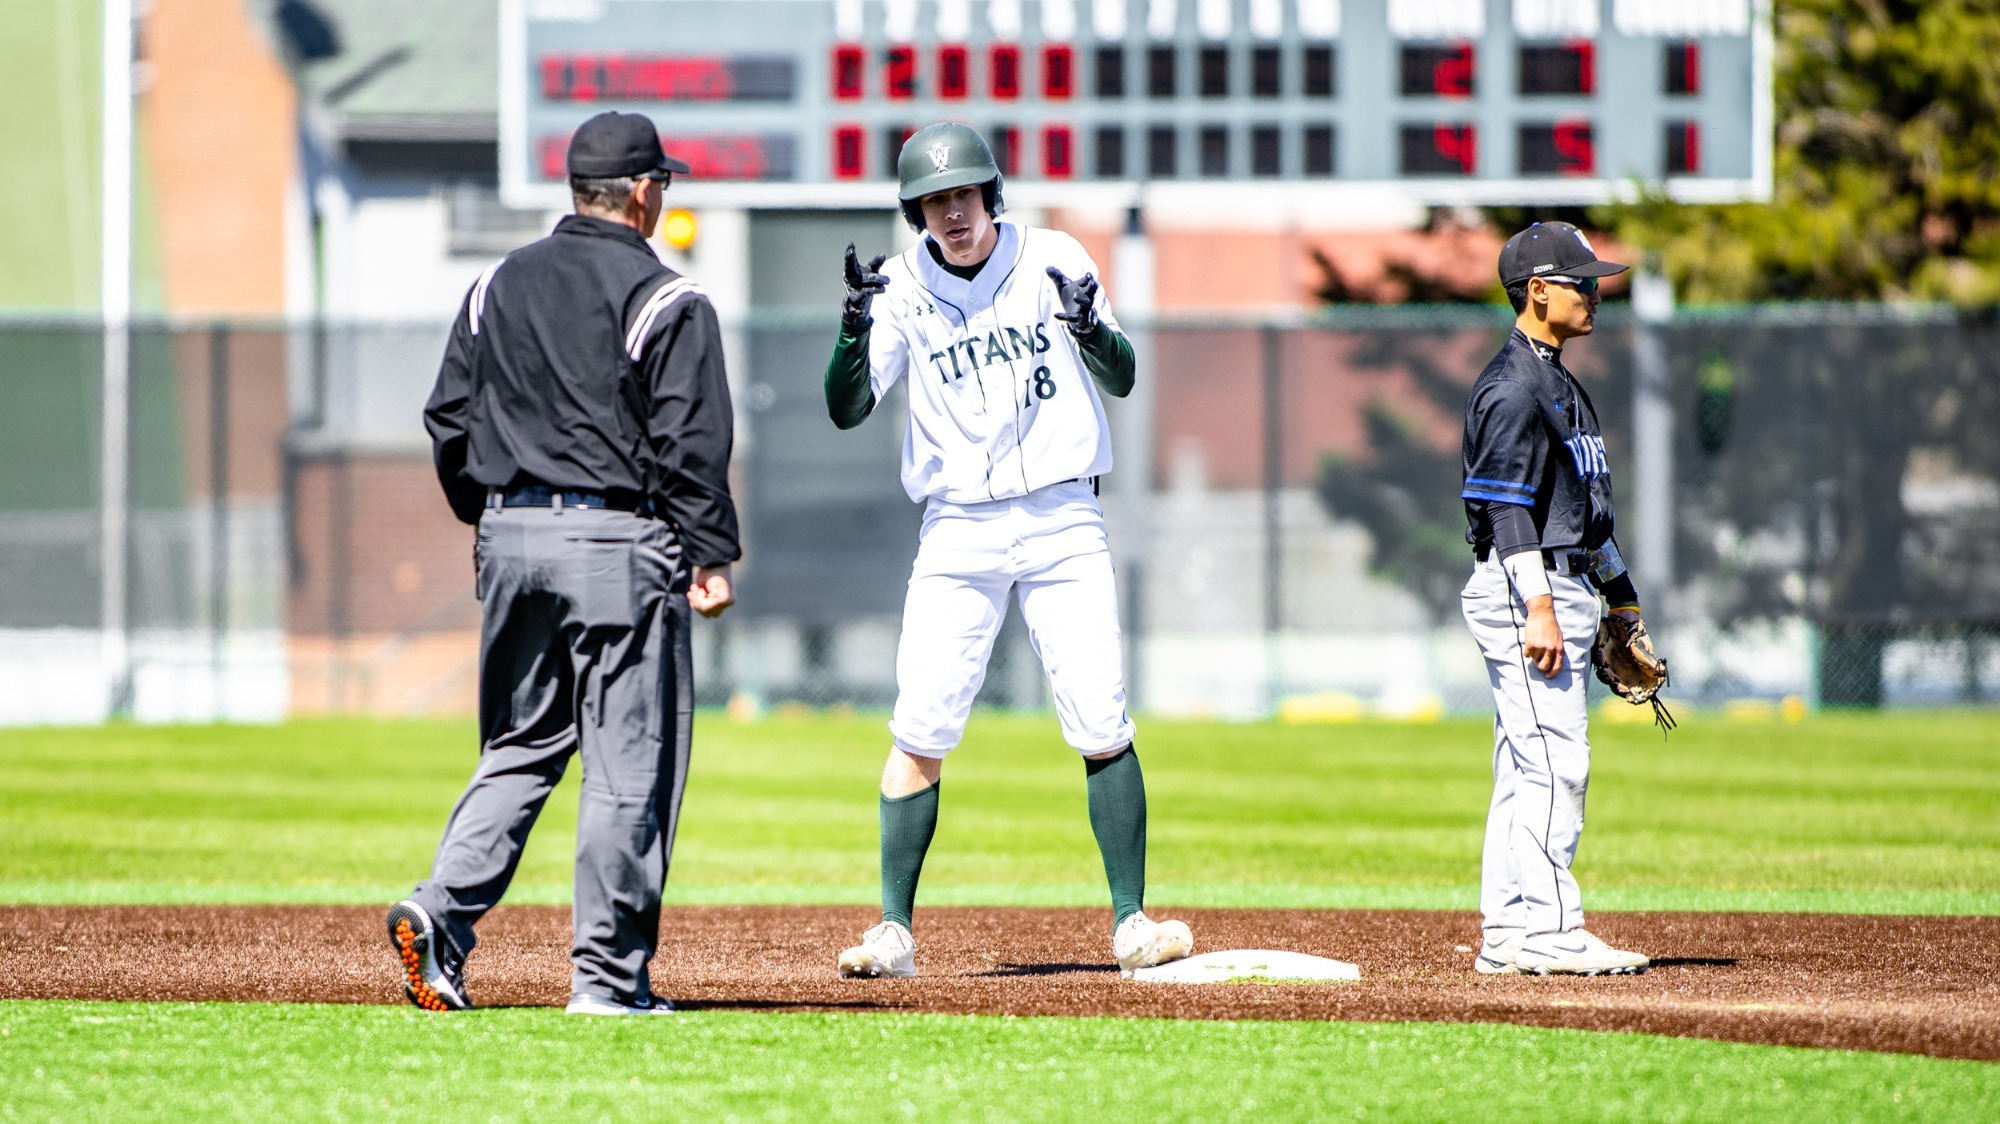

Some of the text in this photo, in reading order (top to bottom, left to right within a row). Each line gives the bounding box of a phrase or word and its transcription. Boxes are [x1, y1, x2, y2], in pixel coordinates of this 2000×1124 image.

[884, 43, 914, 99] 2
[1432, 42, 1474, 98] 2
[1432, 120, 1475, 176] 4
[1552, 117, 1594, 178] 5
[929, 322, 1051, 385] TITANS
[1023, 365, 1057, 409] 18
